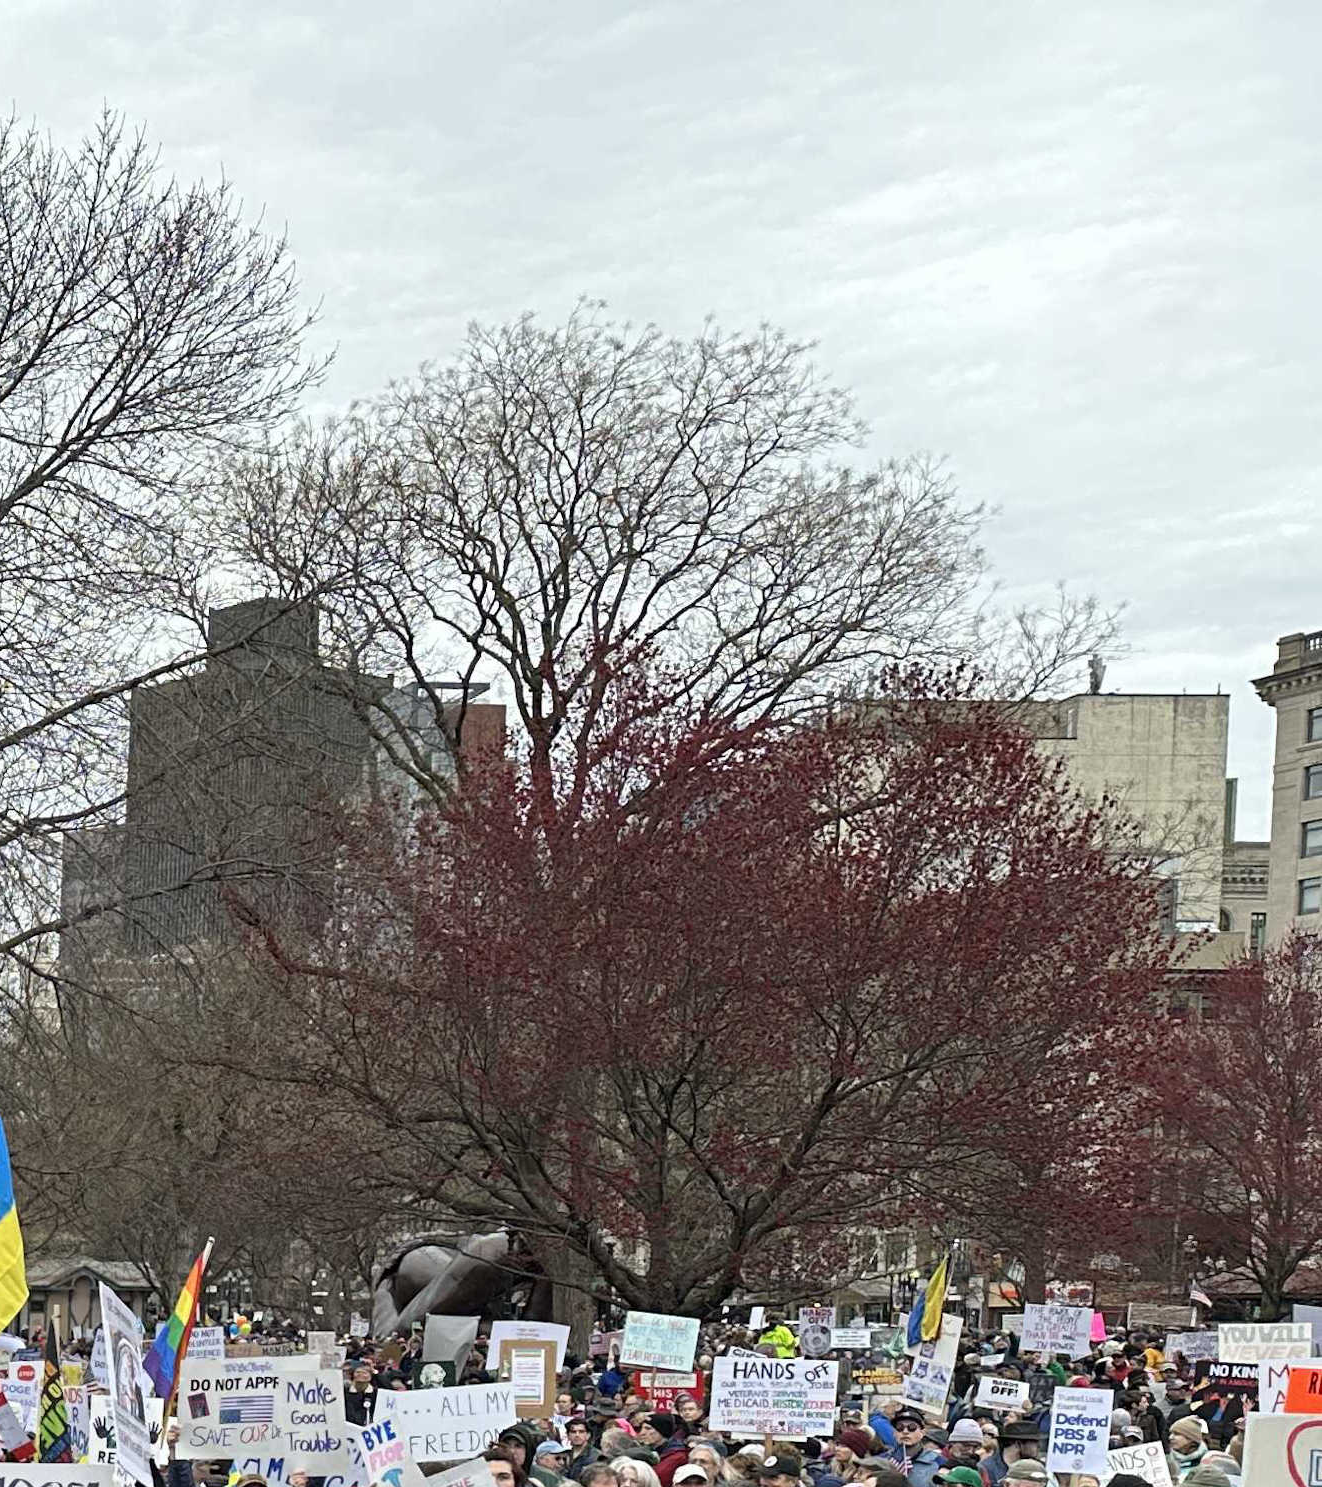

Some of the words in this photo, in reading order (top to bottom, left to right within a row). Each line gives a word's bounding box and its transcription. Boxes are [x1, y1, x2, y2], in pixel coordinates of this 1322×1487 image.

[733, 1361, 796, 1380] HANDS
[804, 1361, 831, 1385] OFF
[1209, 1364, 1230, 1378] NO
[190, 1379, 211, 1391] DO
[215, 1378, 242, 1391] NOT
[286, 1378, 337, 1406] Make
[990, 1386, 1019, 1397] OFF!
[440, 1394, 477, 1418] ALL
[485, 1391, 510, 1413] MY
[290, 1410, 326, 1425] Good
[1056, 1413, 1109, 1428] Defend
[361, 1419, 397, 1452] BYE
[1054, 1427, 1085, 1441] PBS
[1086, 1428, 1098, 1441] &
[1053, 1442, 1086, 1456] NPR
